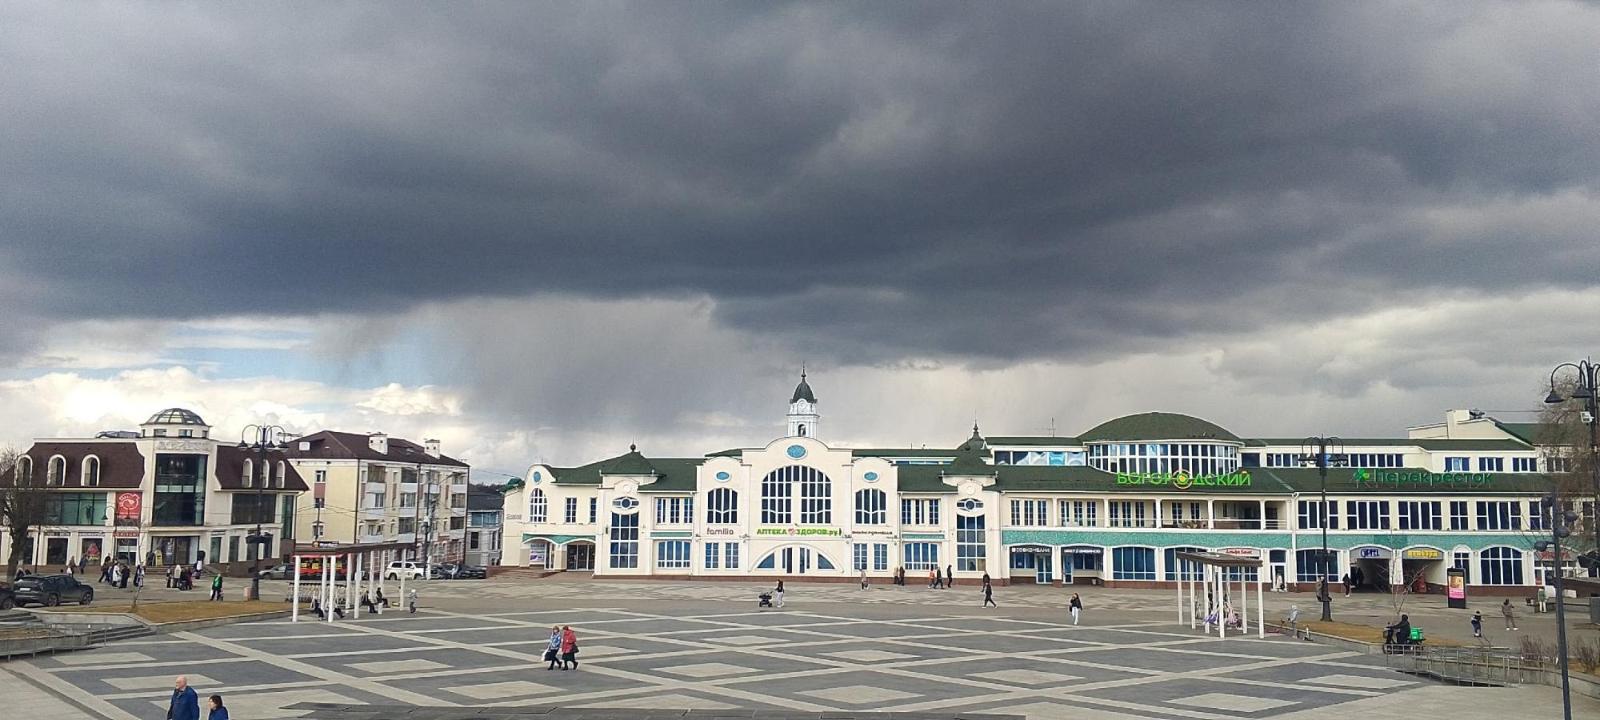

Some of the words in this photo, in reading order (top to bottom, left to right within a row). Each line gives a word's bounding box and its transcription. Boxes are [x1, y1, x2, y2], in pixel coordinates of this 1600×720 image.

[1117, 471, 1251, 487] БОГОРОДСКИЙ
[1374, 469, 1493, 484] Перекресток
[706, 527, 734, 535] familia
[796, 528, 838, 536] ЗДОРОВ.ру
